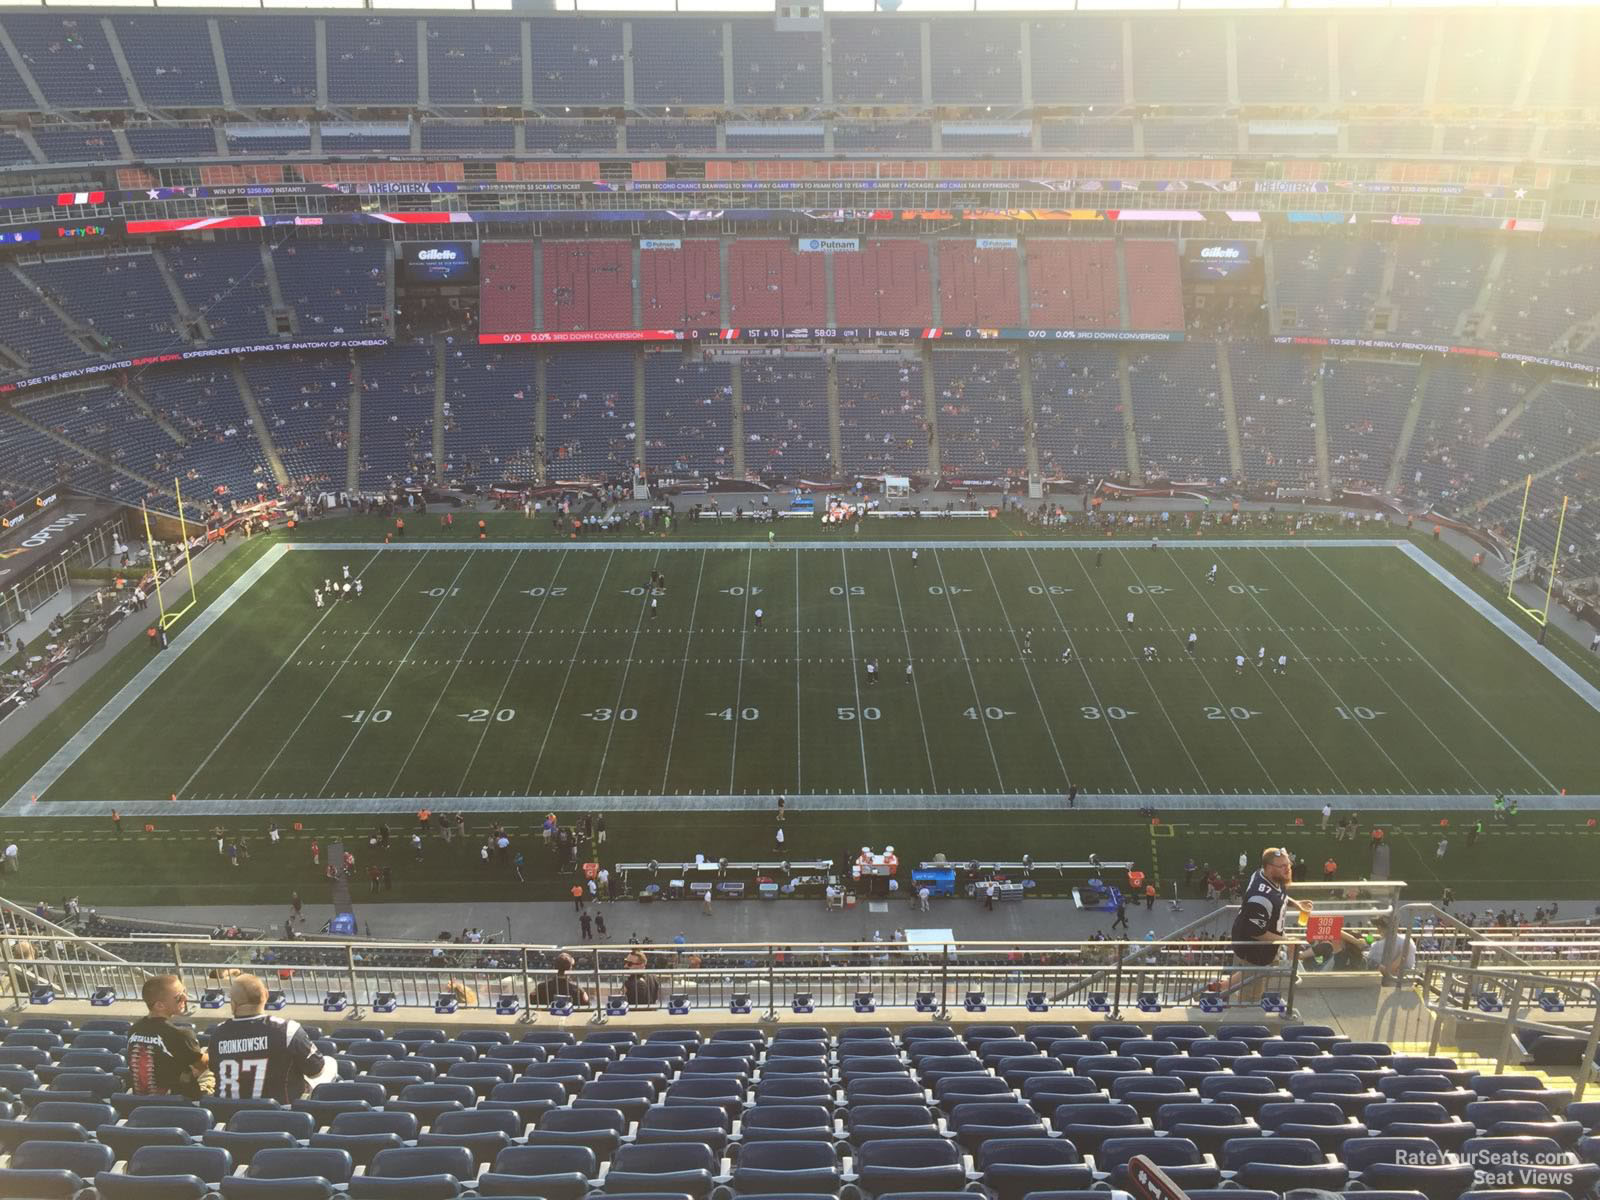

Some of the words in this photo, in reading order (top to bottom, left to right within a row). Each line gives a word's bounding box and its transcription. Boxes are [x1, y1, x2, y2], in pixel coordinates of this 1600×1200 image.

[418, 249, 457, 260] Gillette
[1201, 247, 1239, 257] Gillette
[531, 333, 551, 341] 0.0%
[748, 329, 760, 337] 1ST
[770, 329, 778, 337] 10
[815, 329, 836, 337] 58:03
[899, 329, 910, 337] 45
[1055, 330, 1075, 338] 0.0%
[1373, 340, 1401, 348] NEWLY
[1402, 342, 1448, 352] RENOVATED
[1501, 352, 1549, 365] EXPERIENCE
[1550, 359, 1593, 372] FEATURING
[16, 380, 26, 388] TO
[28, 378, 42, 386] SEE
[43, 374, 58, 383] THE
[59, 369, 85, 380] NEWLY
[86, 360, 131, 374] RENOVATED
[183, 347, 230, 359] EXPERIENCE
[231, 344, 274, 353] FEATURING
[292, 341, 328, 350] ANATOMY
[348, 339, 388, 347] COMEBACK
[21, 513, 87, 547] OPTUM
[352, 709, 392, 723] 10
[467, 708, 516, 722] 20
[592, 708, 638, 722] 30
[718, 707, 760, 721] 40
[837, 707, 881, 720] 50
[963, 707, 1004, 720] 40
[1080, 707, 1128, 720] 30
[1203, 707, 1251, 720] 20
[1334, 706, 1377, 719] 10
[1258, 883, 1271, 894] 87
[1318, 918, 1334, 926] 309
[1317, 926, 1331, 935] 310
[218, 1035, 268, 1055] GRONKOWSKI
[218, 1057, 269, 1099] 87
